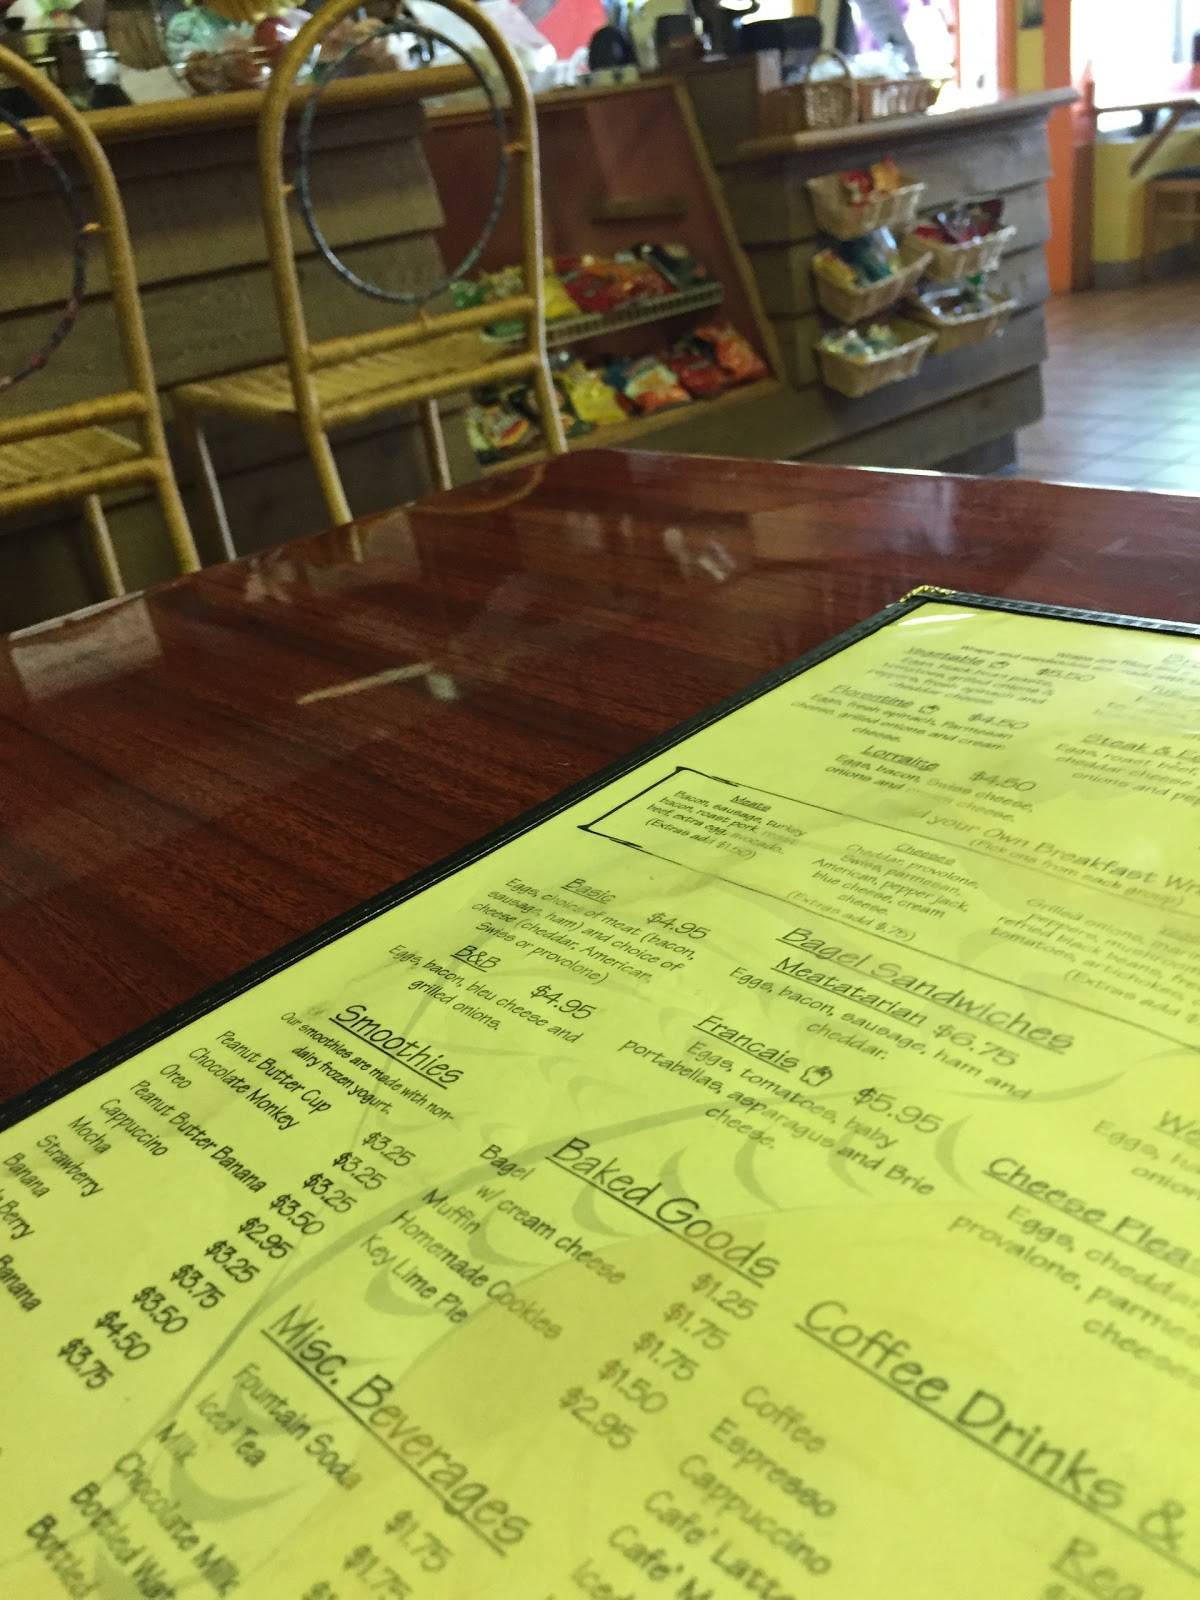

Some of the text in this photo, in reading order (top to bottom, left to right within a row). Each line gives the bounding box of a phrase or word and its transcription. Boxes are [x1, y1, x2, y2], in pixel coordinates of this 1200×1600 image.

[968, 713, 1029, 729] $4.50
[874, 780, 905, 790] and
[969, 770, 1037, 792] $4.50
[1132, 785, 1171, 796] and
[811, 858, 879, 885] American,
[879, 880, 934, 899] pepper
[811, 870, 840, 885] blue
[897, 900, 946, 918] cream
[983, 828, 1030, 847] Own
[1034, 842, 1158, 883] Breakfast
[471, 902, 517, 923] cheese
[514, 918, 580, 951] (cheddar,
[475, 921, 610, 985] Swiss or provolone)
[505, 878, 696, 961] Eggs, choice of meat (bacon,
[544, 912, 585, 932] ham)
[581, 926, 615, 943] and
[610, 939, 661, 963] choice
[660, 960, 685, 972] of
[564, 878, 711, 939] Basic $4.95
[388, 944, 585, 1044] Eggs, bacon, bleu cheese and
[408, 979, 499, 1031] grilled onions.
[454, 944, 597, 1020] B&B $4.95
[729, 966, 1033, 1100] Eggs, bacon, sausage, ham and
[775, 957, 928, 1025] Meatatarian
[933, 1024, 1021, 1067] $6.75
[782, 927, 873, 968] Bagel
[865, 962, 1076, 1051] Sandwiches
[281, 1012, 454, 1121] Our smoothies are made with non-
[291, 1046, 393, 1115] dairy frozen yogurt.
[335, 1003, 464, 1085] Smoothies
[697, 1015, 944, 1134] Francais $5.95
[806, 1022, 890, 1060] cheddar.
[159, 1063, 358, 1214] Oreo $3.25
[189, 1047, 388, 1191] Chocolate Monkey $3.25
[216, 1029, 416, 1168] Peanut Butter Cup $3.25
[617, 1039, 935, 1195] portabellas, asparagus and Brie
[687, 1040, 899, 1150] Eggs, tomatoes, baby
[704, 1107, 776, 1150] cheese.
[68, 1115, 260, 1284] Mocha $3.25
[100, 1098, 294, 1259] Cappuccino $2.95
[130, 1079, 325, 1236] Peanut Butter Banana $3.50
[552, 1136, 781, 1280] Baked Goods
[988, 1156, 1108, 1224] Cheese
[2, 1151, 189, 1335] Banana $3.50
[36, 1134, 226, 1309] Strawberry $3.75
[476, 1185, 731, 1351] w/ cream cheese $1.75
[479, 1143, 759, 1321] Bagel $1.25
[1007, 1203, 1075, 1253] Eggs,
[0, 1200, 151, 1361] Berry $4.50
[391, 1209, 669, 1414] Homemade Cookies $1.50
[421, 1187, 699, 1382] Muffin $1.75
[58, 1337, 114, 1390] $3.75
[360, 1233, 638, 1450] Key Lime Pie $2.95
[231, 1425, 267, 1468] Tea
[233, 1361, 312, 1441] Fountain
[270, 1304, 532, 1546] Misc. Beverages
[741, 1385, 828, 1454] Coffee
[805, 1300, 1187, 1552] Coffee Drinks &
[678, 1454, 833, 1576] Cappuccino
[709, 1416, 837, 1518] Espresso
